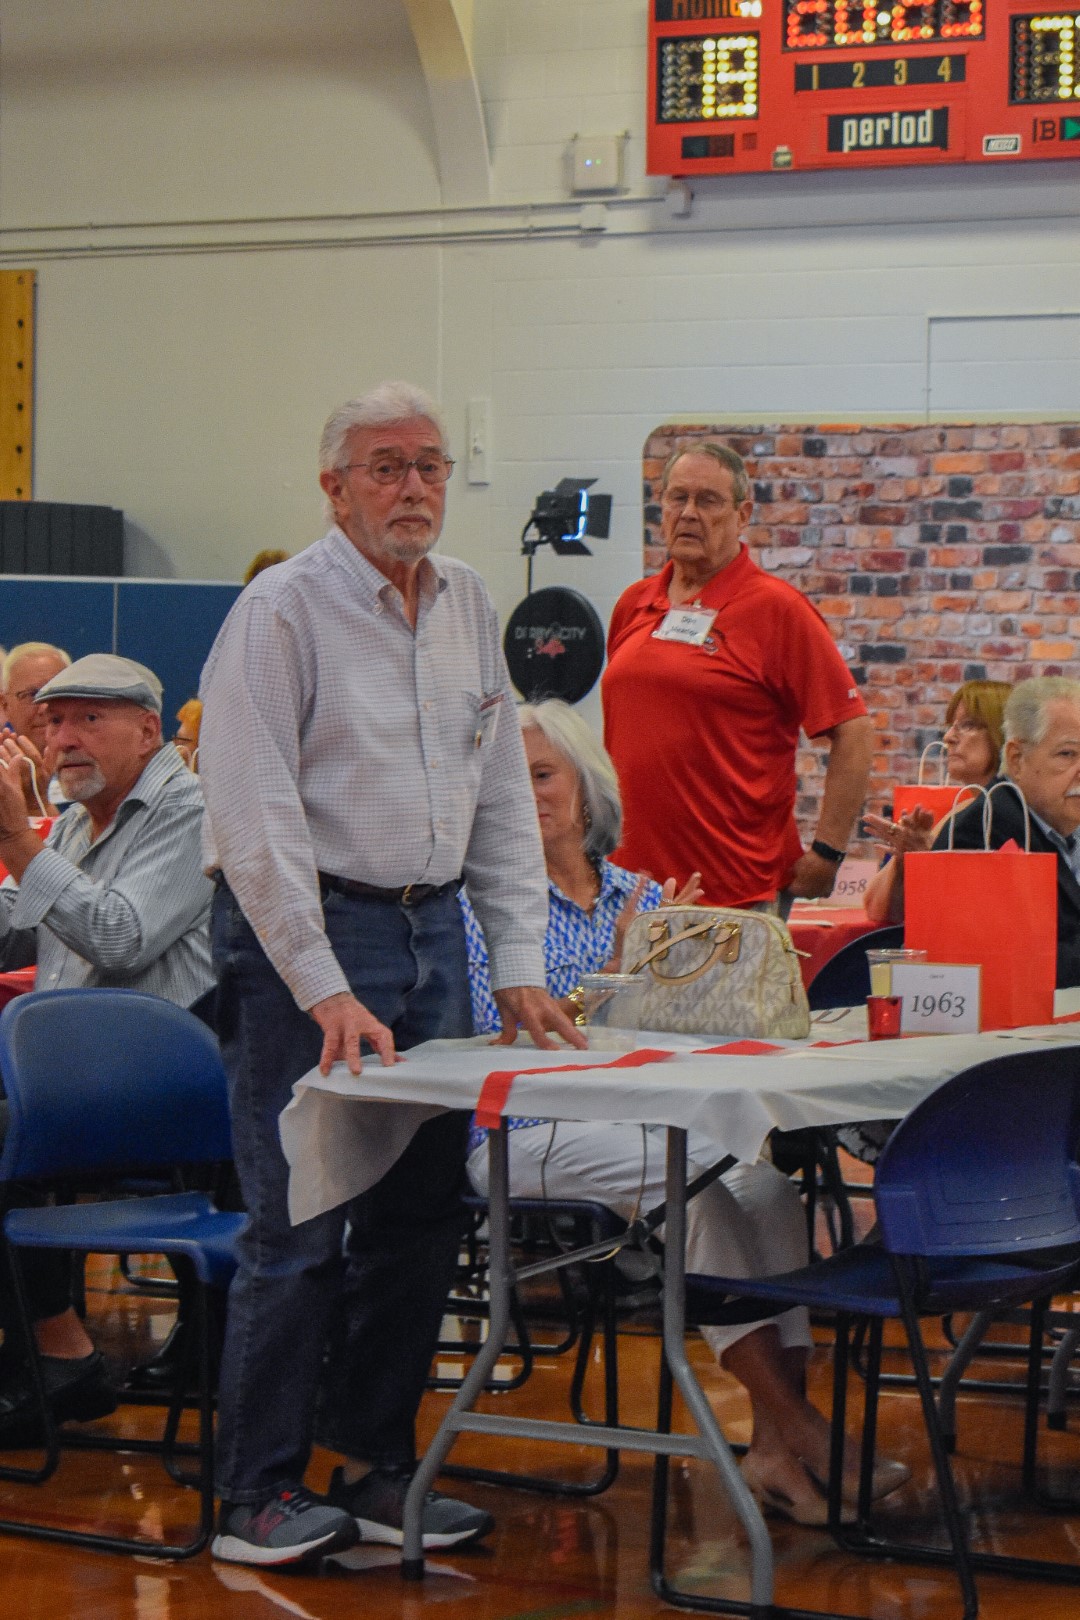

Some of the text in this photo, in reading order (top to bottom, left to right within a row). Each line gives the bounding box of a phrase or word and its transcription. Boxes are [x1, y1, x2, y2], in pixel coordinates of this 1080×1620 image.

[811, 56, 951, 90] 1 2 3 4
[1030, 15, 1080, 98] 7
[702, 36, 758, 118] 19
[842, 108, 934, 153] period
[836, 878, 868, 896] 958
[911, 991, 966, 1018] 1963
